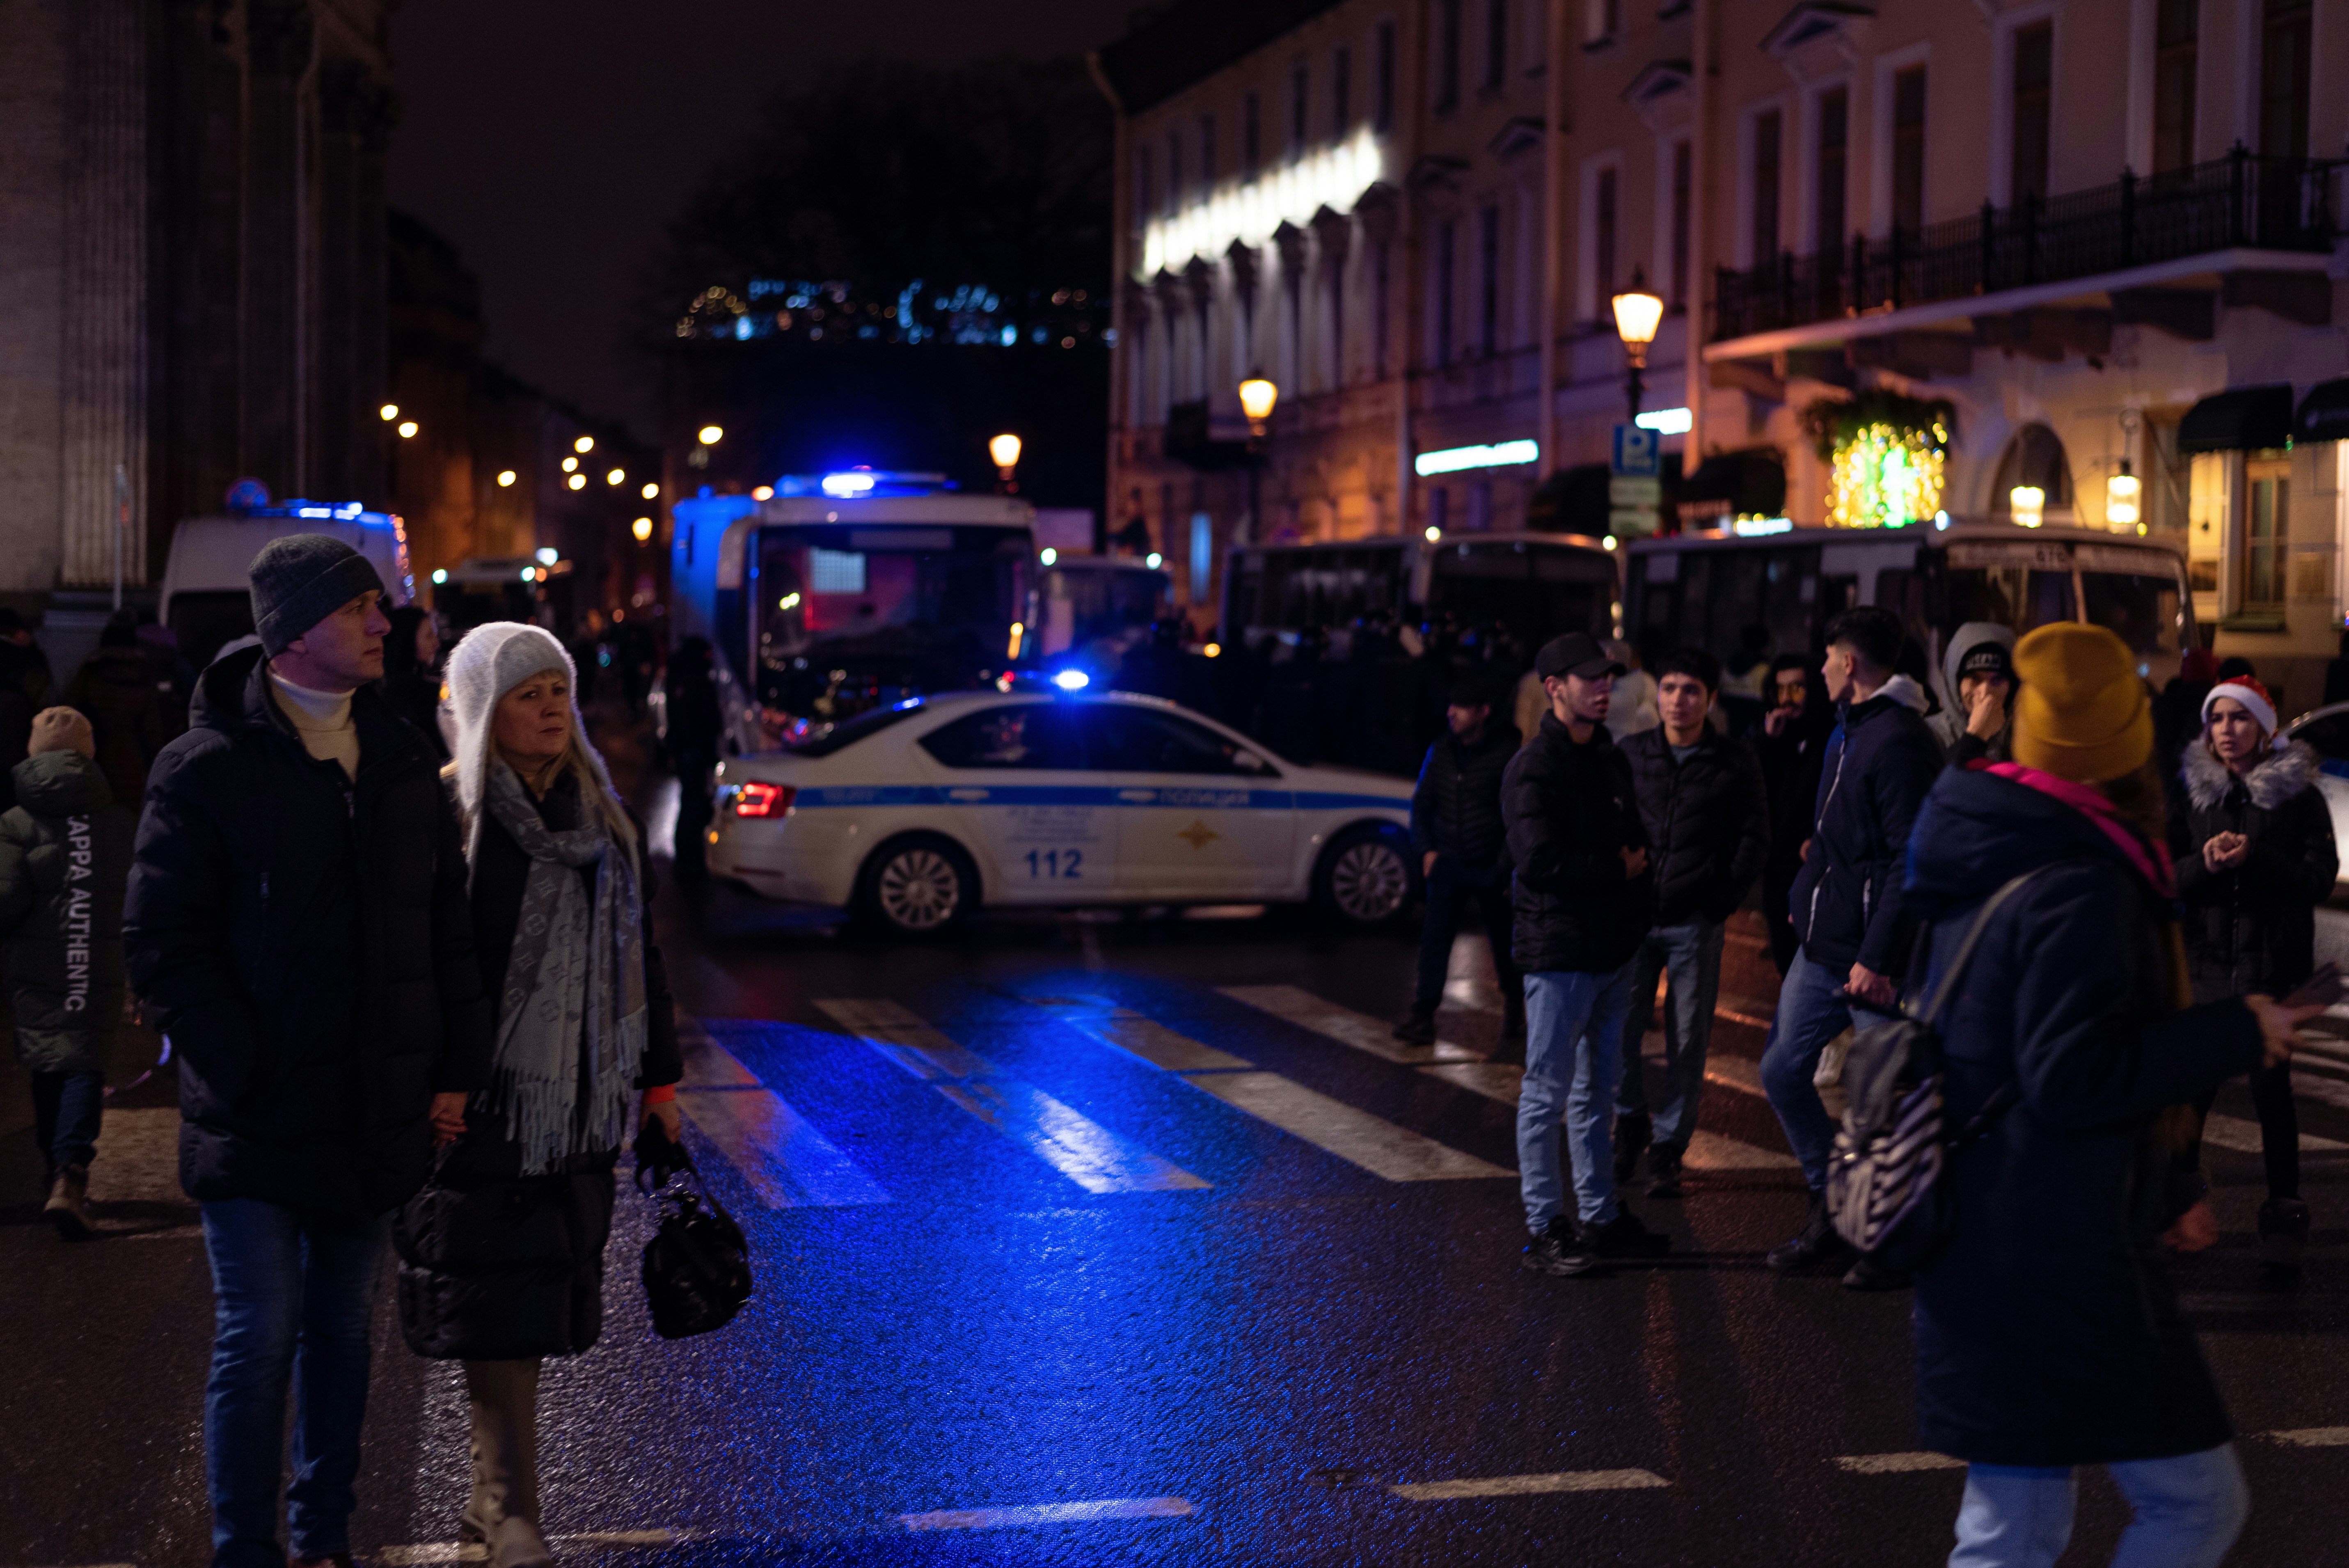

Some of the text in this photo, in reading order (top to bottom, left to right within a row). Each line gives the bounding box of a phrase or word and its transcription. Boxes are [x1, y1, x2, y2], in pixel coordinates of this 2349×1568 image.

[64, 814, 92, 1012] APPA AUTHENTIC
[1026, 849, 1082, 877] 112
